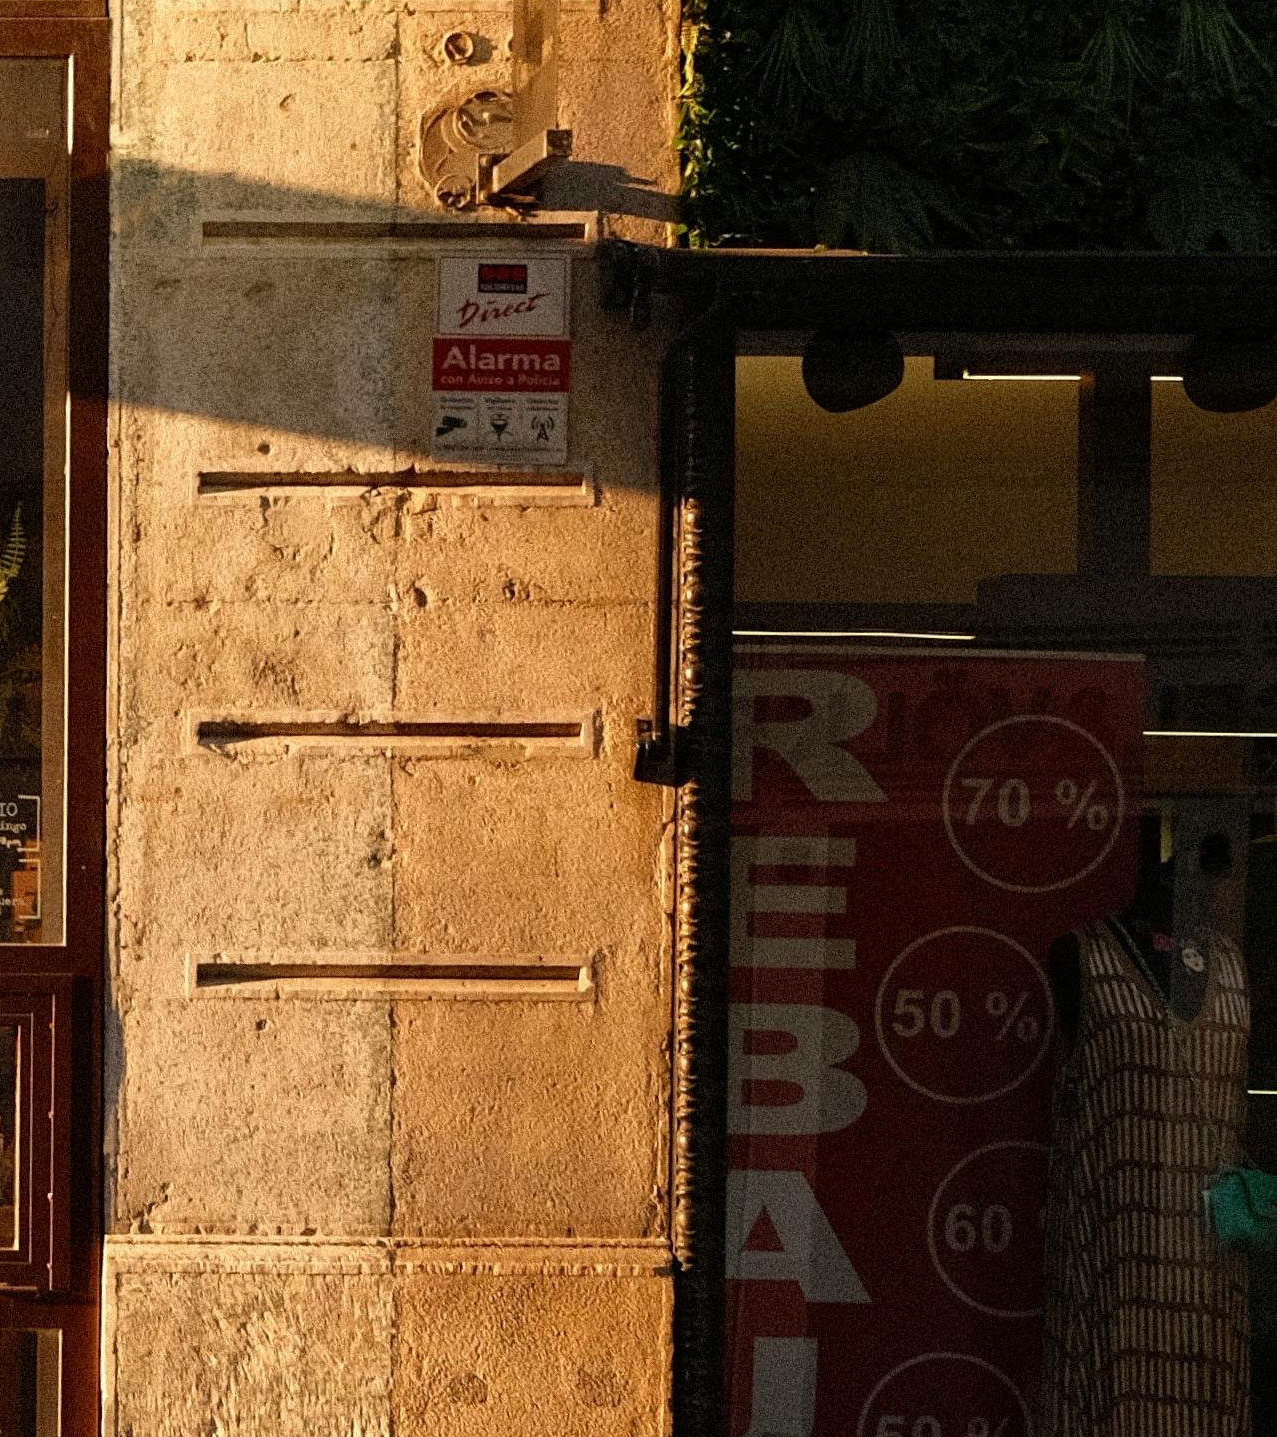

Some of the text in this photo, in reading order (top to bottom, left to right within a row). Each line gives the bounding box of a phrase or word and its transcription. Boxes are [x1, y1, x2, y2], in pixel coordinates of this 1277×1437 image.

[456, 292, 550, 328] Direct
[440, 375, 463, 384] con
[467, 373, 503, 385] Aviso
[507, 376, 515, 385] a
[441, 344, 561, 371] Alarma
[962, 777, 1109, 831] 70 %
[891, 988, 962, 1038] 50
[945, 1203, 1013, 1254] 60
